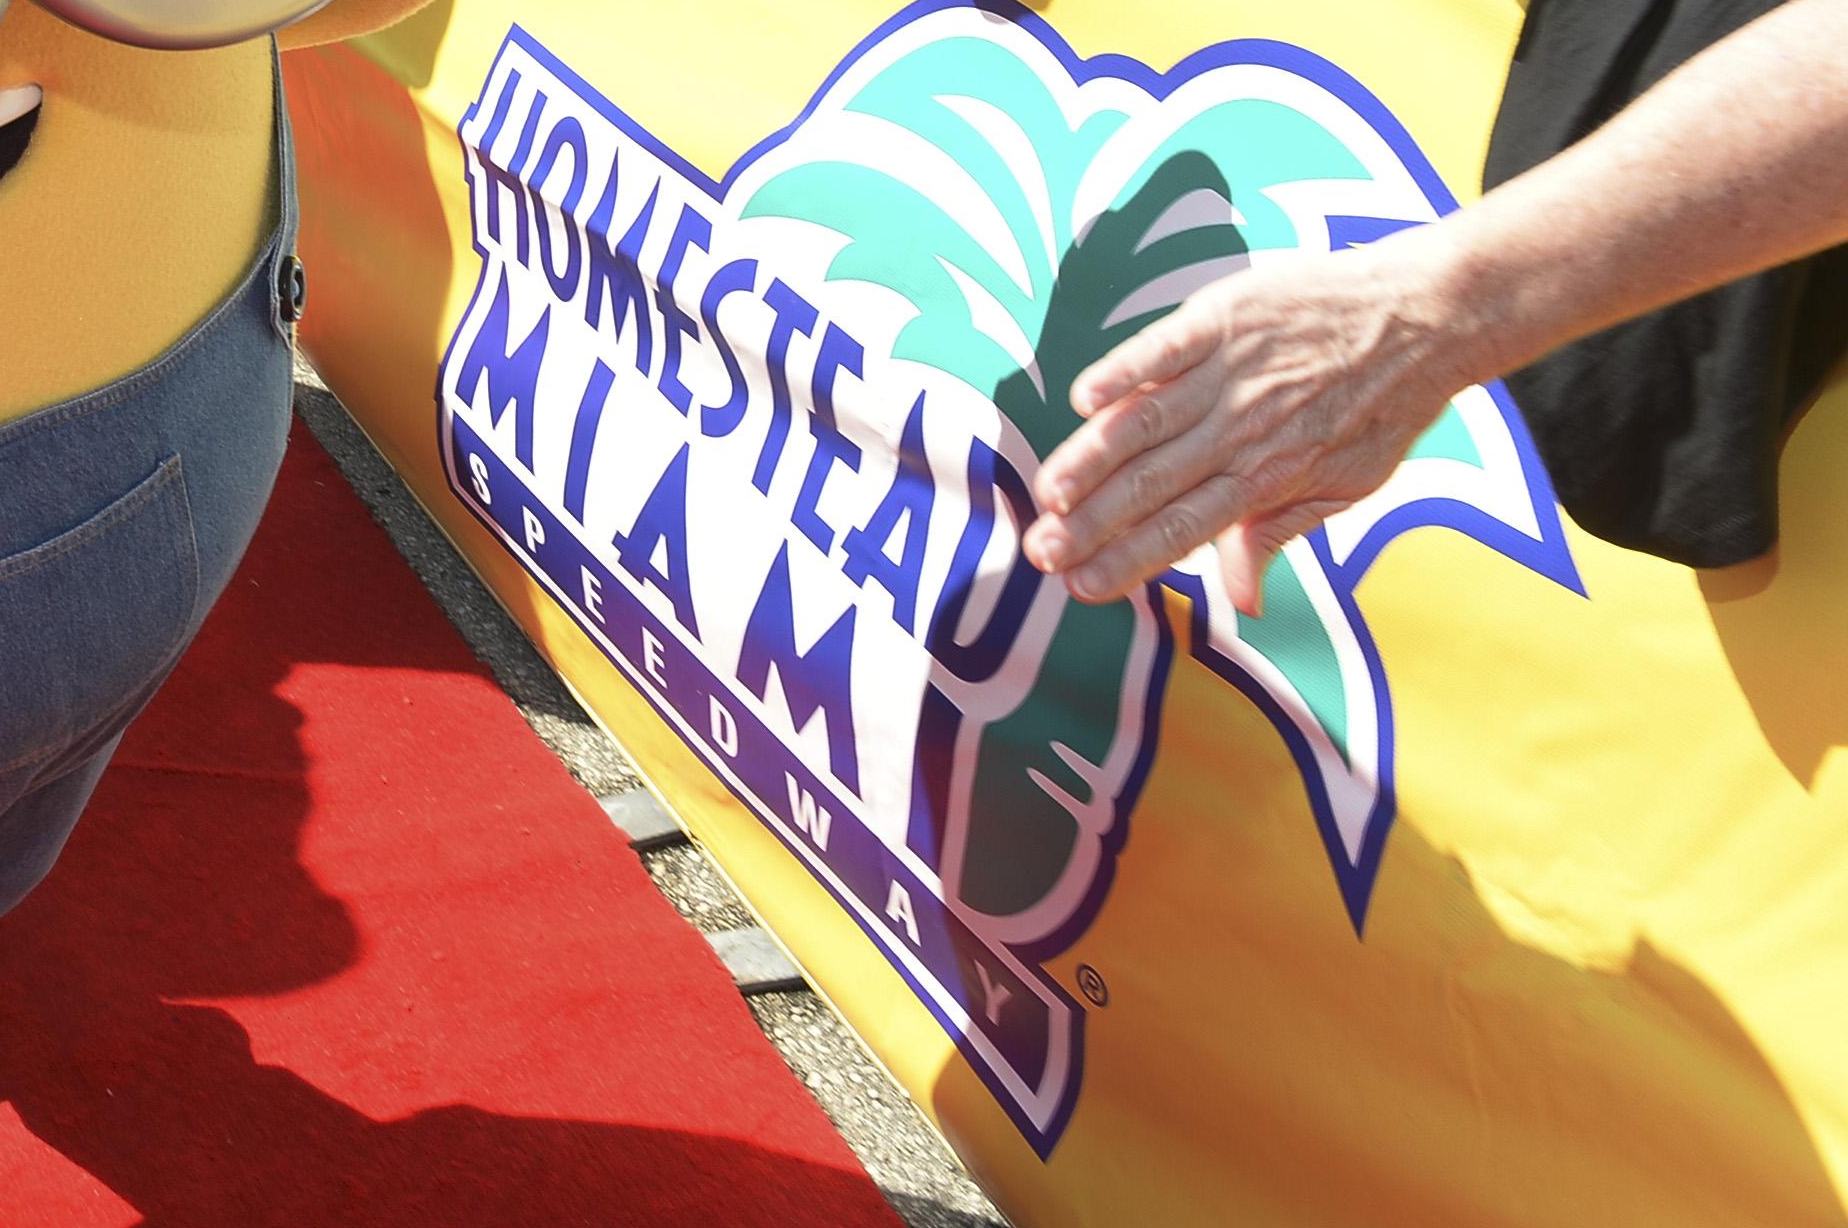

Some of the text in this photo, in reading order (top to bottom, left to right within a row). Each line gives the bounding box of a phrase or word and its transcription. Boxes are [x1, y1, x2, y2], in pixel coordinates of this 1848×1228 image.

[456, 260, 964, 884] MIAMI
[468, 67, 1040, 683] HOMESTEAD
[468, 452, 1012, 1026] SPEEDWAY
